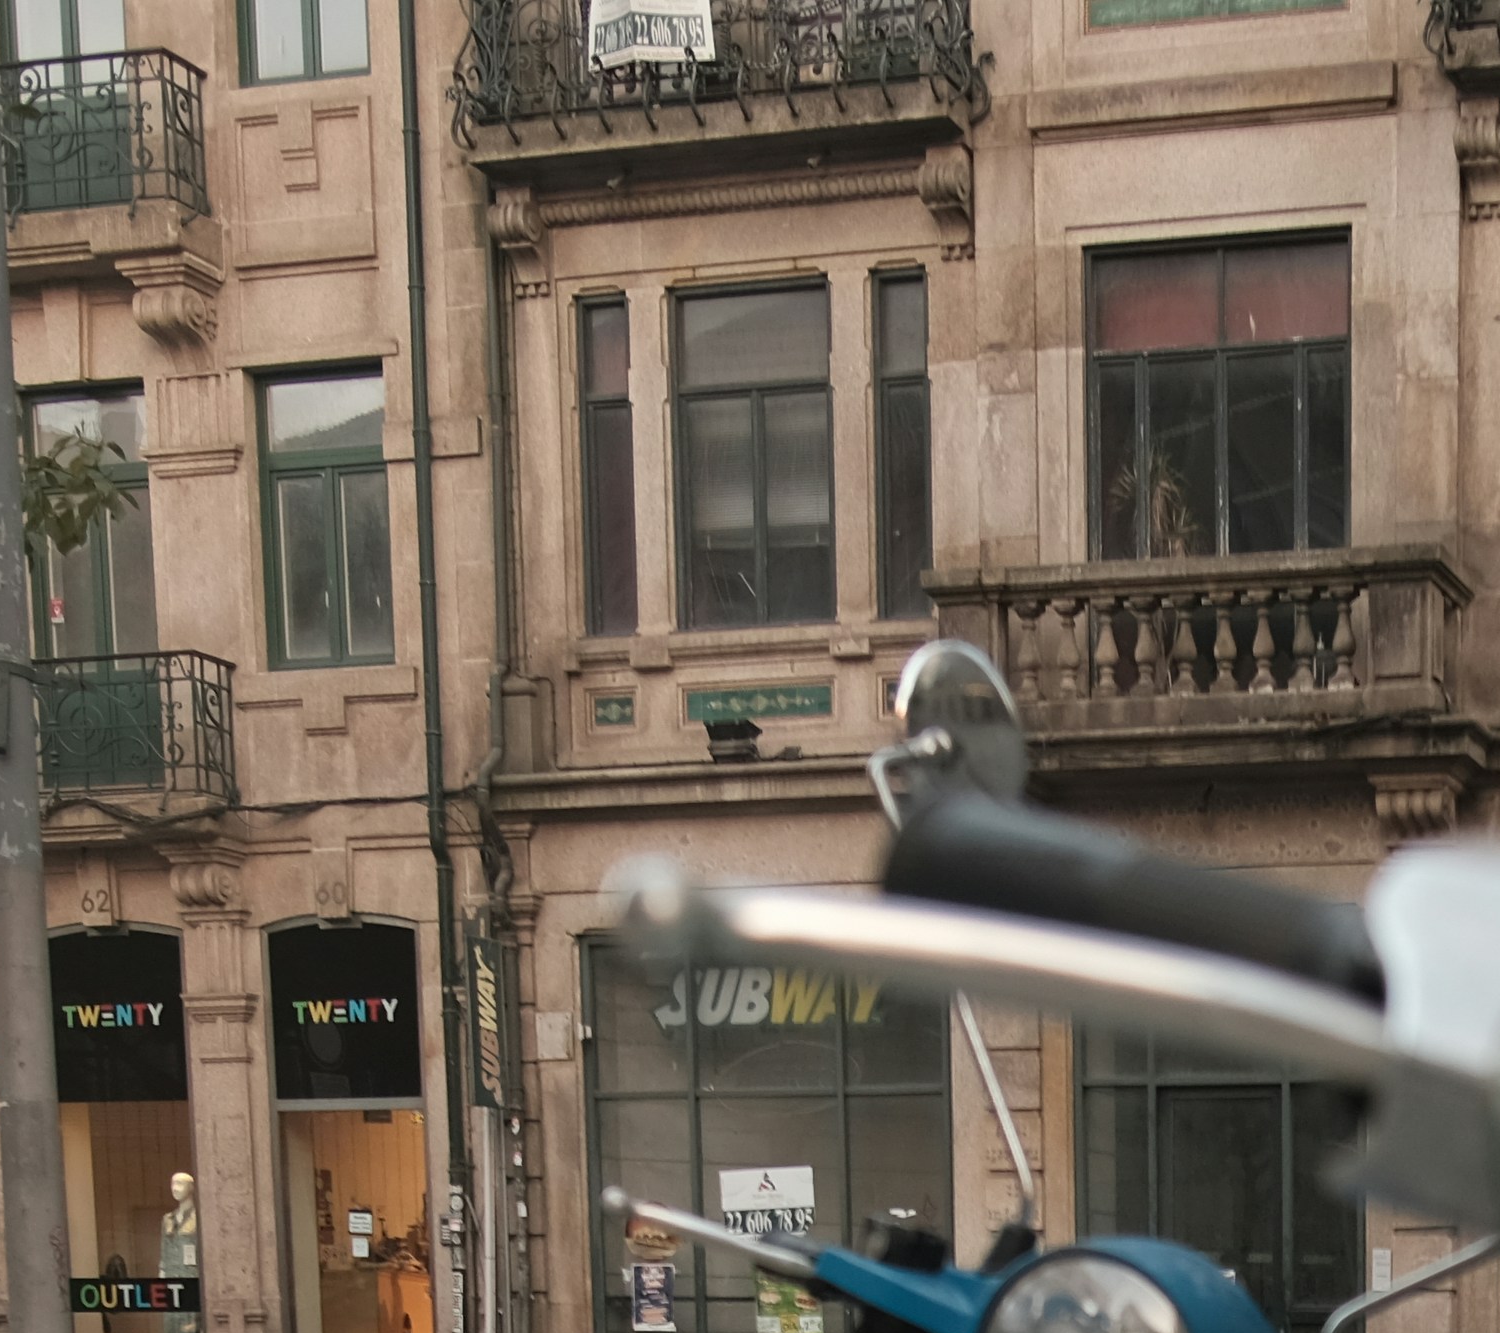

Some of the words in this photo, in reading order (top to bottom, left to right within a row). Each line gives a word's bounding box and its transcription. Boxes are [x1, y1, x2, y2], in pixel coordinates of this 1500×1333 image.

[635, 14, 649, 44] 22
[651, 16, 671, 46] 606
[673, 16, 687, 46] 78
[689, 17, 704, 46] 95
[81, 889, 111, 914] 62
[315, 881, 348, 906] 60
[654, 966, 882, 1029] SUBWAY
[62, 1002, 164, 1028] TWENTY
[292, 998, 398, 1025] TWENTY
[473, 945, 505, 1108] SUBWAY
[725, 1211, 743, 1235] 22
[745, 1210, 773, 1234] 606
[774, 1209, 794, 1233] 78
[795, 1208, 814, 1232] 95
[79, 1283, 185, 1308] OUTLET
